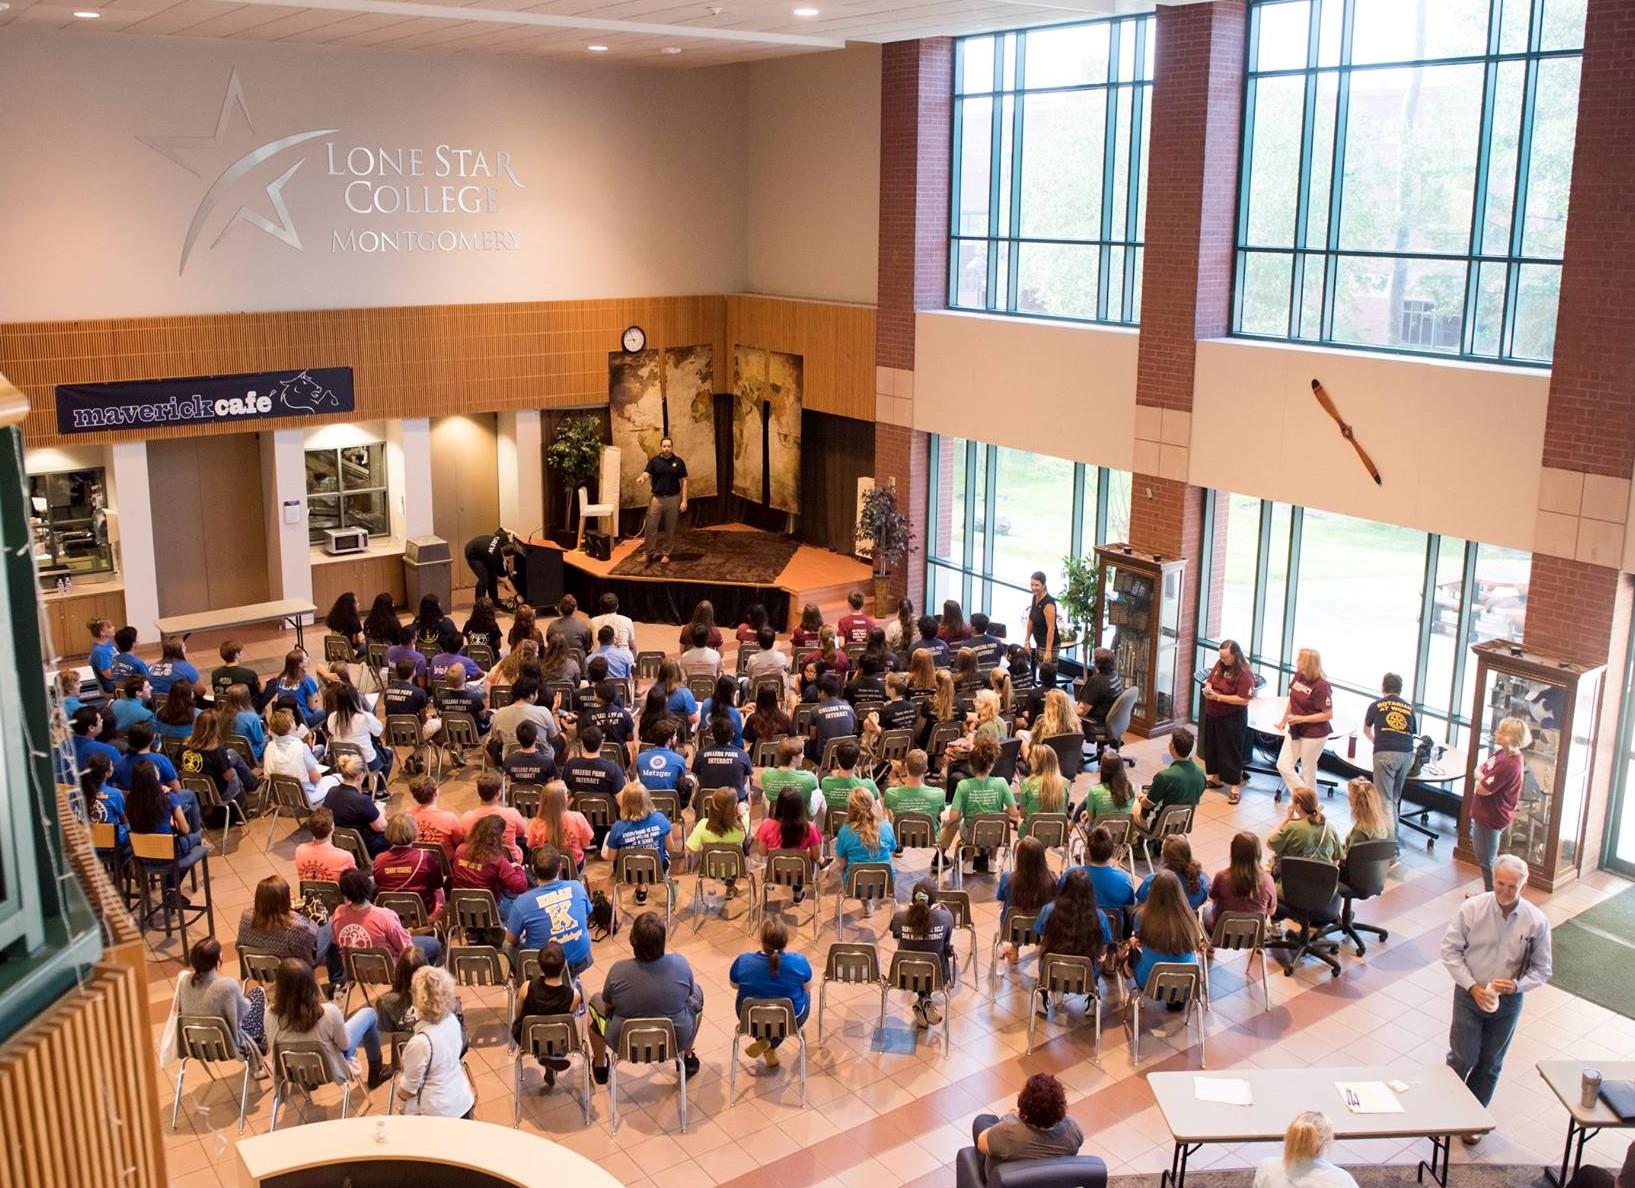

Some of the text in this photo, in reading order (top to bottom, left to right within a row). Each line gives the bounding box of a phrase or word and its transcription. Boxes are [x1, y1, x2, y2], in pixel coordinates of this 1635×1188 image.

[326, 142, 527, 189] LONE STAR
[344, 180, 498, 214] COLLEGE
[331, 228, 522, 254] MONTGOMERY
